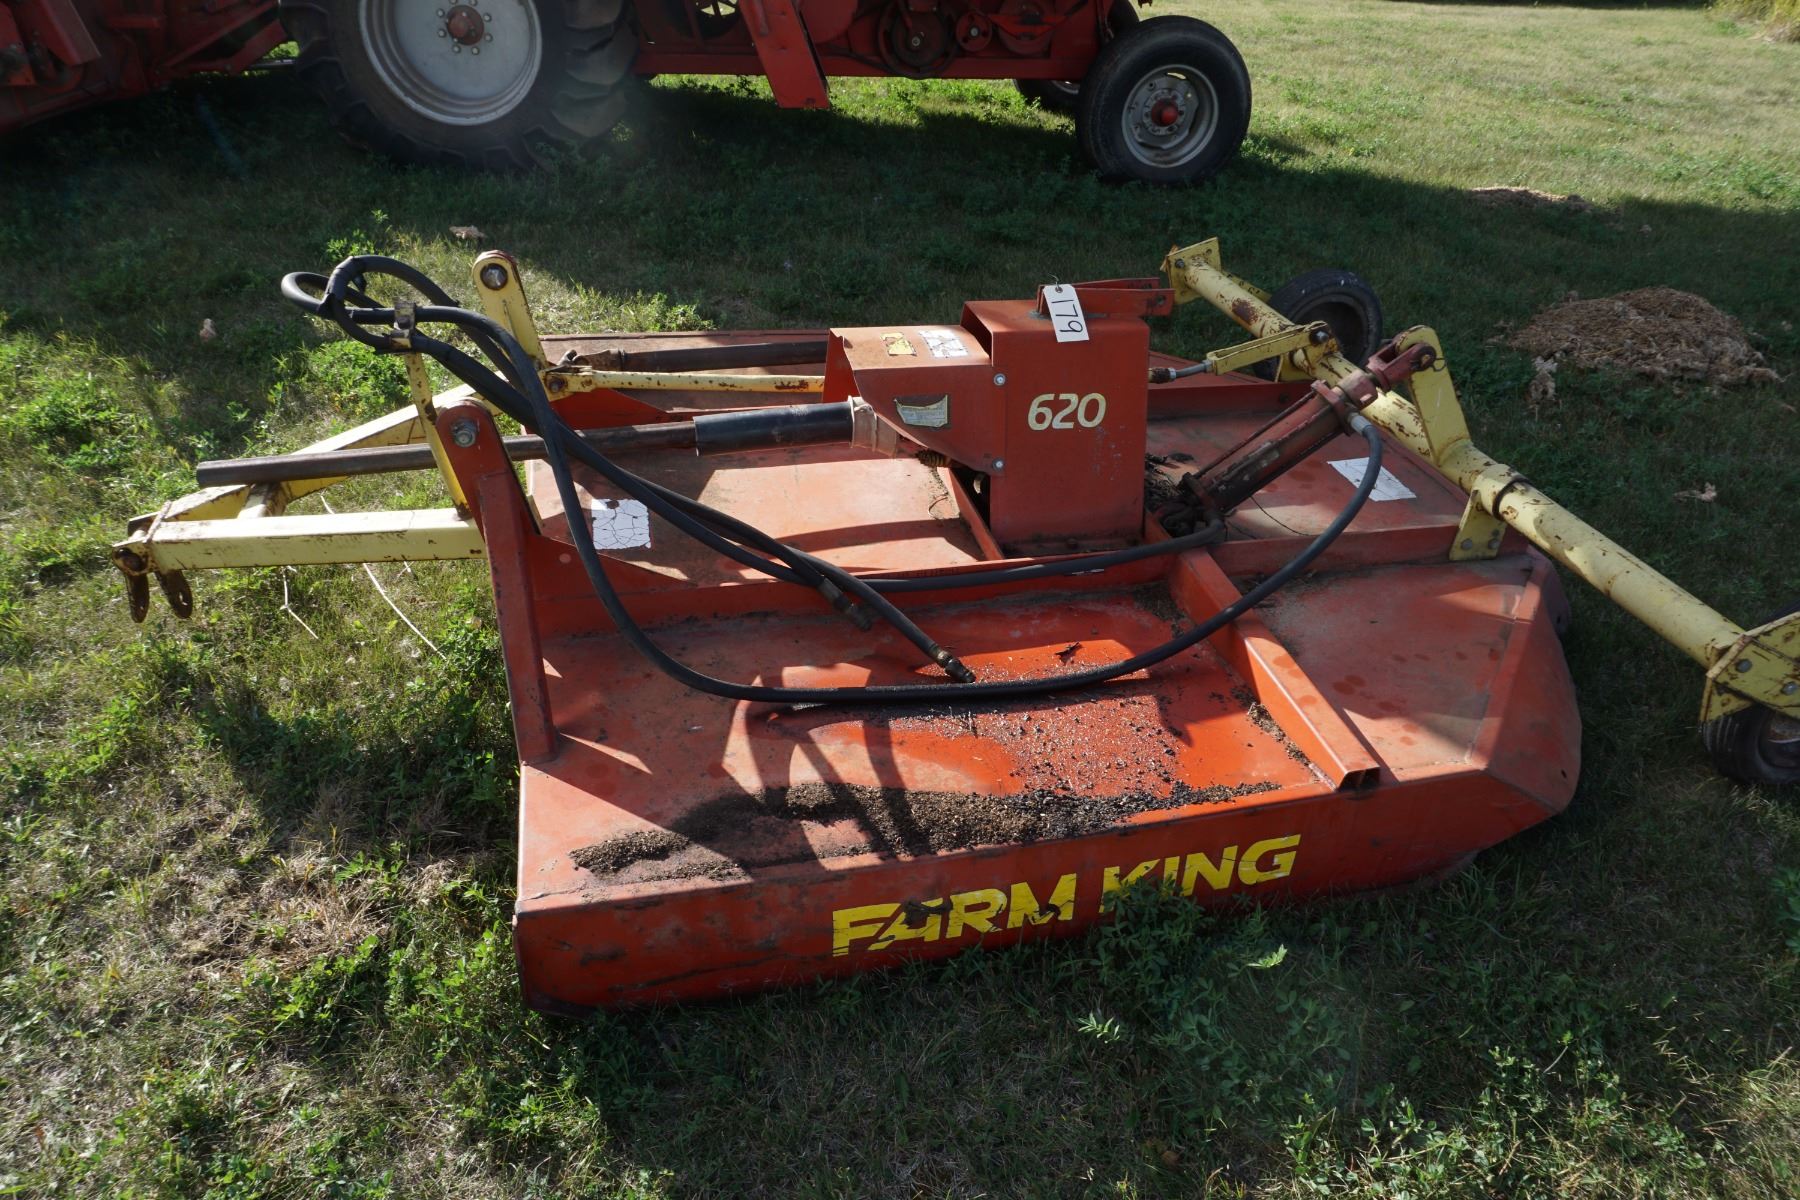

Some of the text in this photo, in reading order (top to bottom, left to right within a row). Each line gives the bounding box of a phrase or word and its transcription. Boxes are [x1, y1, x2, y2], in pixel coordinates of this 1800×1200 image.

[1051, 299, 1084, 333] 179
[1027, 392, 1107, 431] 620
[832, 834, 1301, 957] FARM KING
